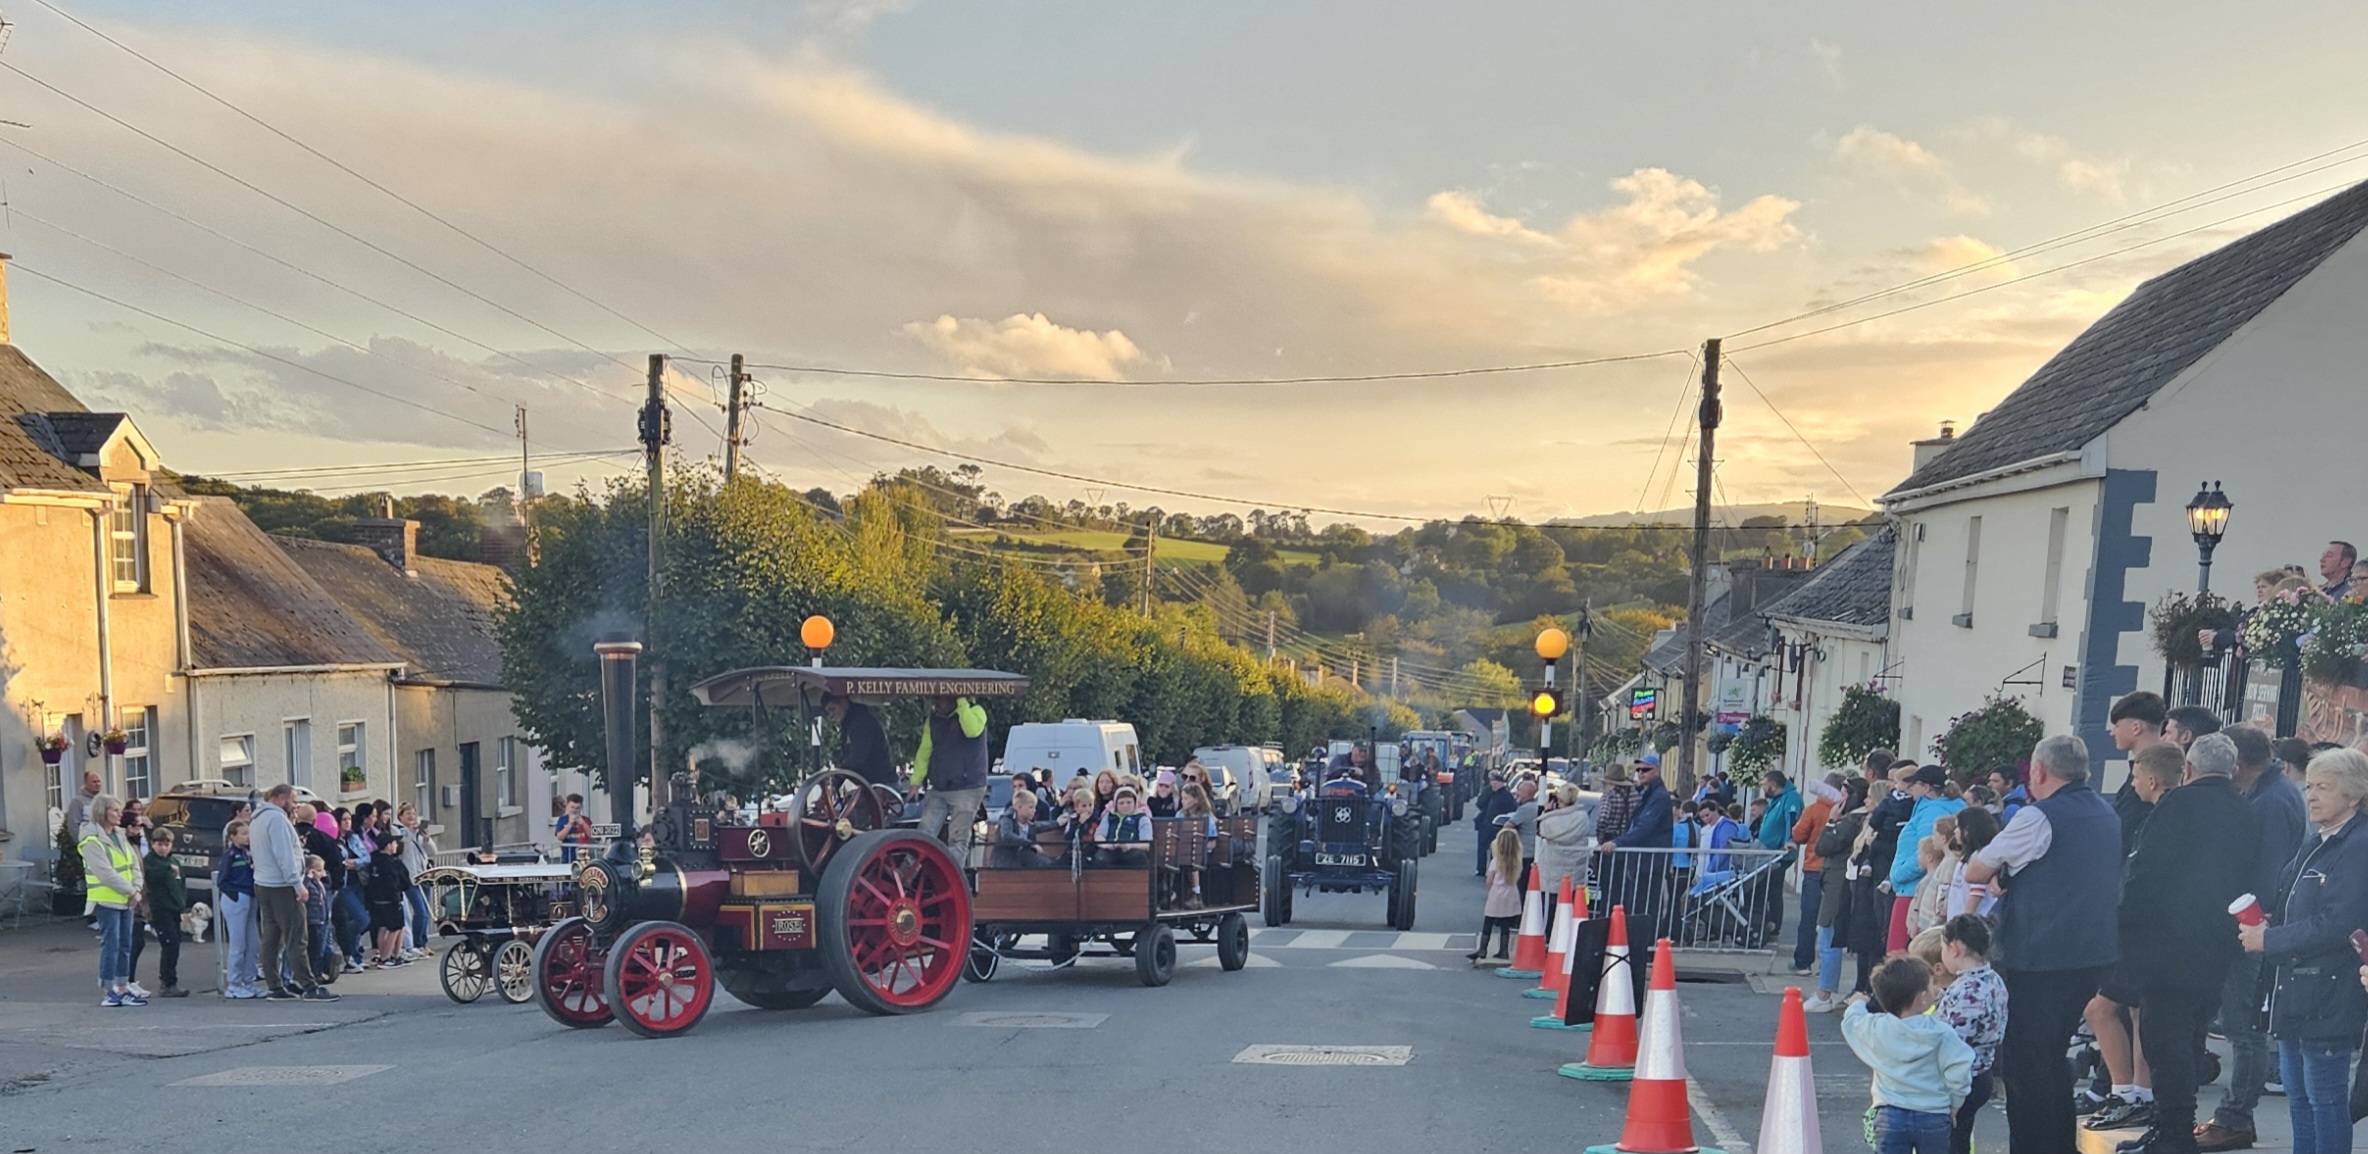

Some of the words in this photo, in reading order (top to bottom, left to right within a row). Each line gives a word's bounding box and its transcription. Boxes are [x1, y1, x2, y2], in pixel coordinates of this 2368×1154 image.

[846, 681, 855, 694] P.
[858, 681, 892, 694] KELLY
[895, 681, 936, 695] FAMILY
[939, 681, 1015, 695] ENGINEERING
[1322, 854, 1334, 864] ZE
[1340, 854, 1360, 864] 7115
[778, 920, 801, 931] ROSE
